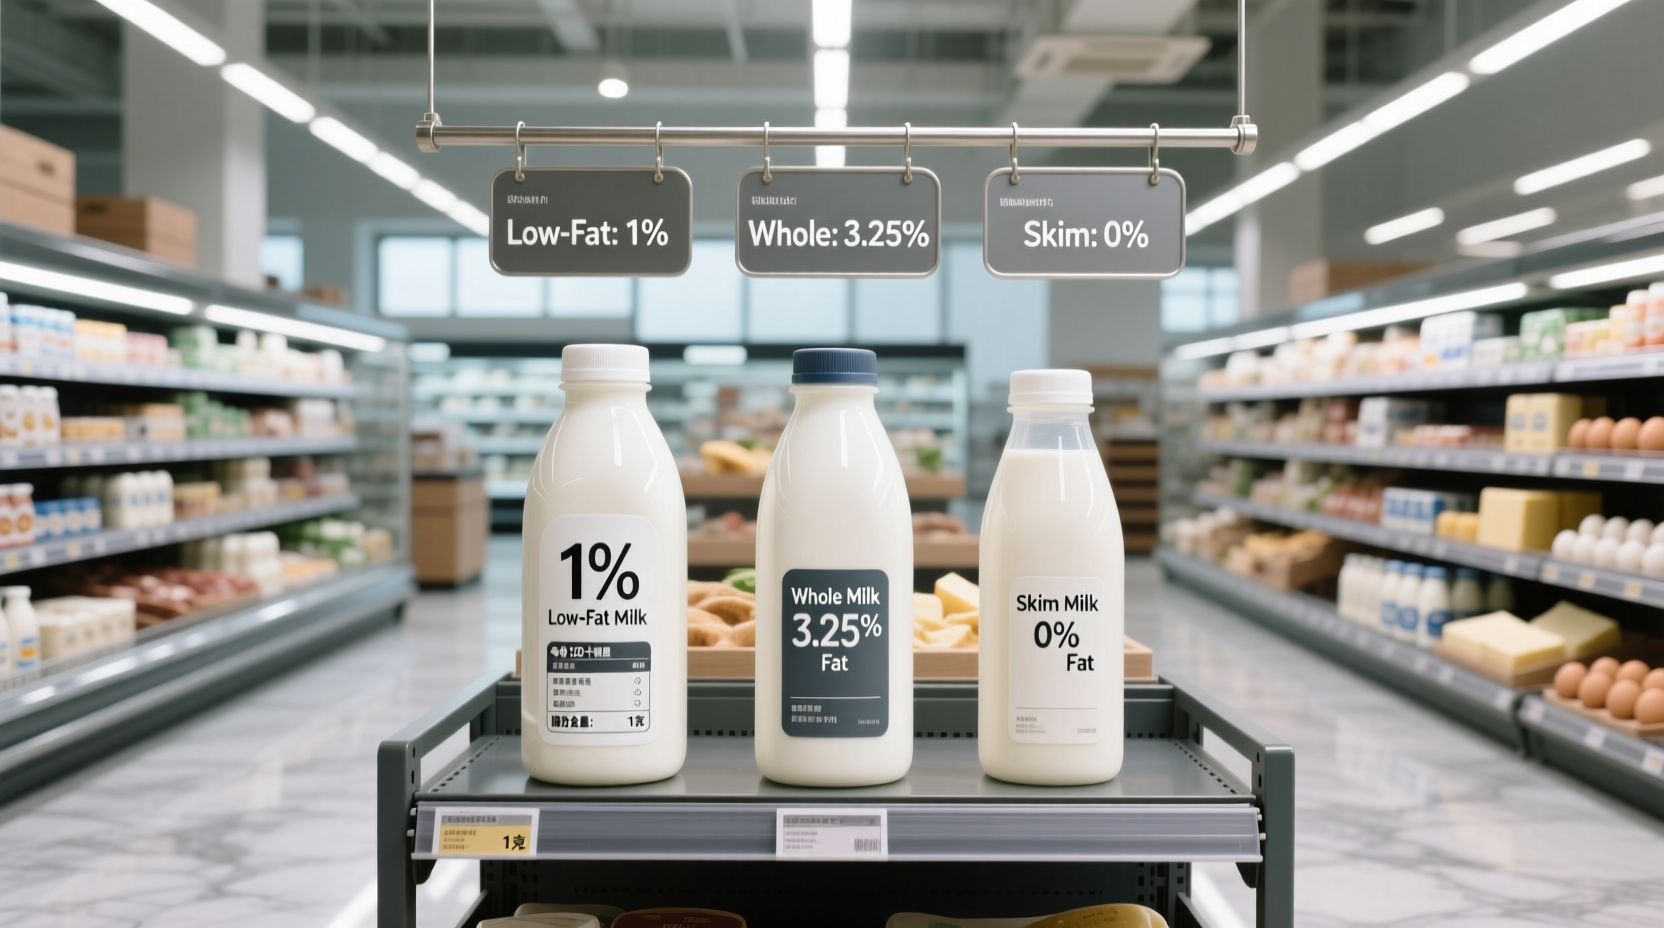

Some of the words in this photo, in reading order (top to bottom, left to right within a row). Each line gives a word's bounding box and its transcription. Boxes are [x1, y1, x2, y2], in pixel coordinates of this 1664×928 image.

[507, 218, 619, 246] Low-Fat:
[626, 218, 669, 246] 1%
[748, 219, 838, 247] Whole:
[843, 219, 930, 248] 3.25%
[1023, 220, 1098, 248] Skim:
[1103, 220, 1149, 248] 0%
[560, 541, 640, 601] 1%
[791, 586, 843, 605] Whole
[846, 586, 881, 605] Milk
[1016, 594, 1060, 612] Skim
[1064, 594, 1099, 612] Milk
[548, 608, 610, 626] Low-Fat
[614, 608, 647, 626] Milk
[791, 612, 883, 648] 3.25%
[1033, 620, 1080, 649] 0%
[821, 653, 849, 672] Fat
[1066, 653, 1095, 672] Fat
